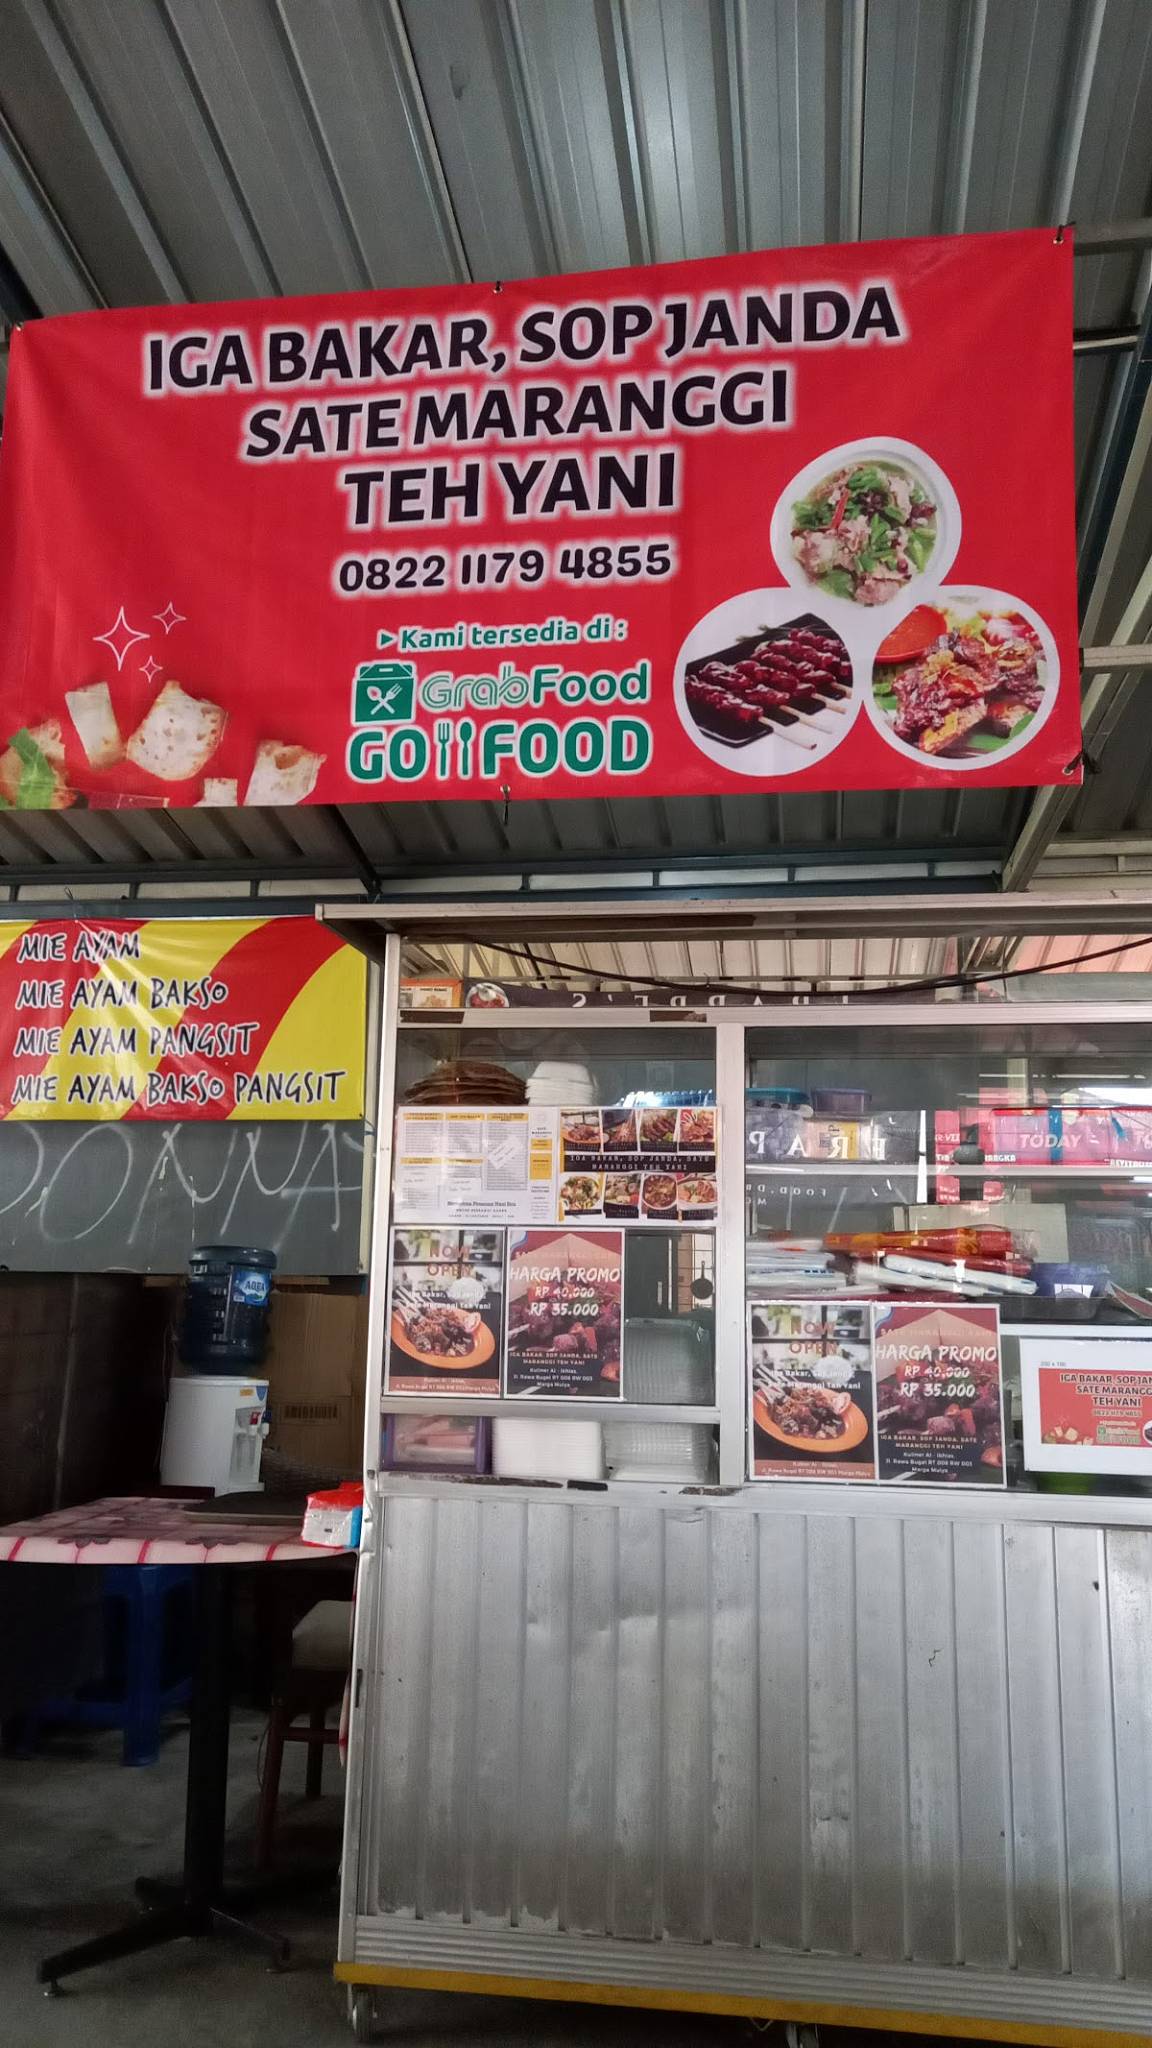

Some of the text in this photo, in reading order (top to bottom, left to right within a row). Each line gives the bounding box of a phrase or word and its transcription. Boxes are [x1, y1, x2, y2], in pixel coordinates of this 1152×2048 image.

[148, 285, 901, 391] IGA BAKAR, SOP JANDA
[246, 369, 788, 457] SATE MARANGGI
[344, 451, 676, 526] TEH YANI
[338, 542, 672, 593] 0822 1179 4855
[400, 626, 464, 651] Kami
[470, 618, 579, 648] tersedia
[420, 661, 650, 709] GrabFood
[18, 931, 140, 961] MIE AYAM
[16, 977, 228, 1009] MIE AYAM BAKSO
[14, 1023, 259, 1056] MIE AYAM PANGSIT
[12, 1070, 346, 1105] MIE AYAM BAKSO PANGSIT
[1019, 1133, 1082, 1149] TODAY
[427, 1263, 473, 1277] OPEN
[509, 1266, 621, 1284] HARGA PROMO
[551, 1302, 599, 1316] 35.000
[790, 1321, 837, 1334] NOW
[789, 1341, 839, 1355] OPEN
[875, 1343, 997, 1363] HARGA PROMO
[904, 1365, 920, 1378] RP
[1060, 1373, 1077, 1382] IGA
[1117, 1375, 1135, 1384] SOP
[899, 1381, 976, 1398] RP 35.000
[1076, 1385, 1100, 1394] SATE
[1093, 1396, 1142, 1407] TEH YANI
